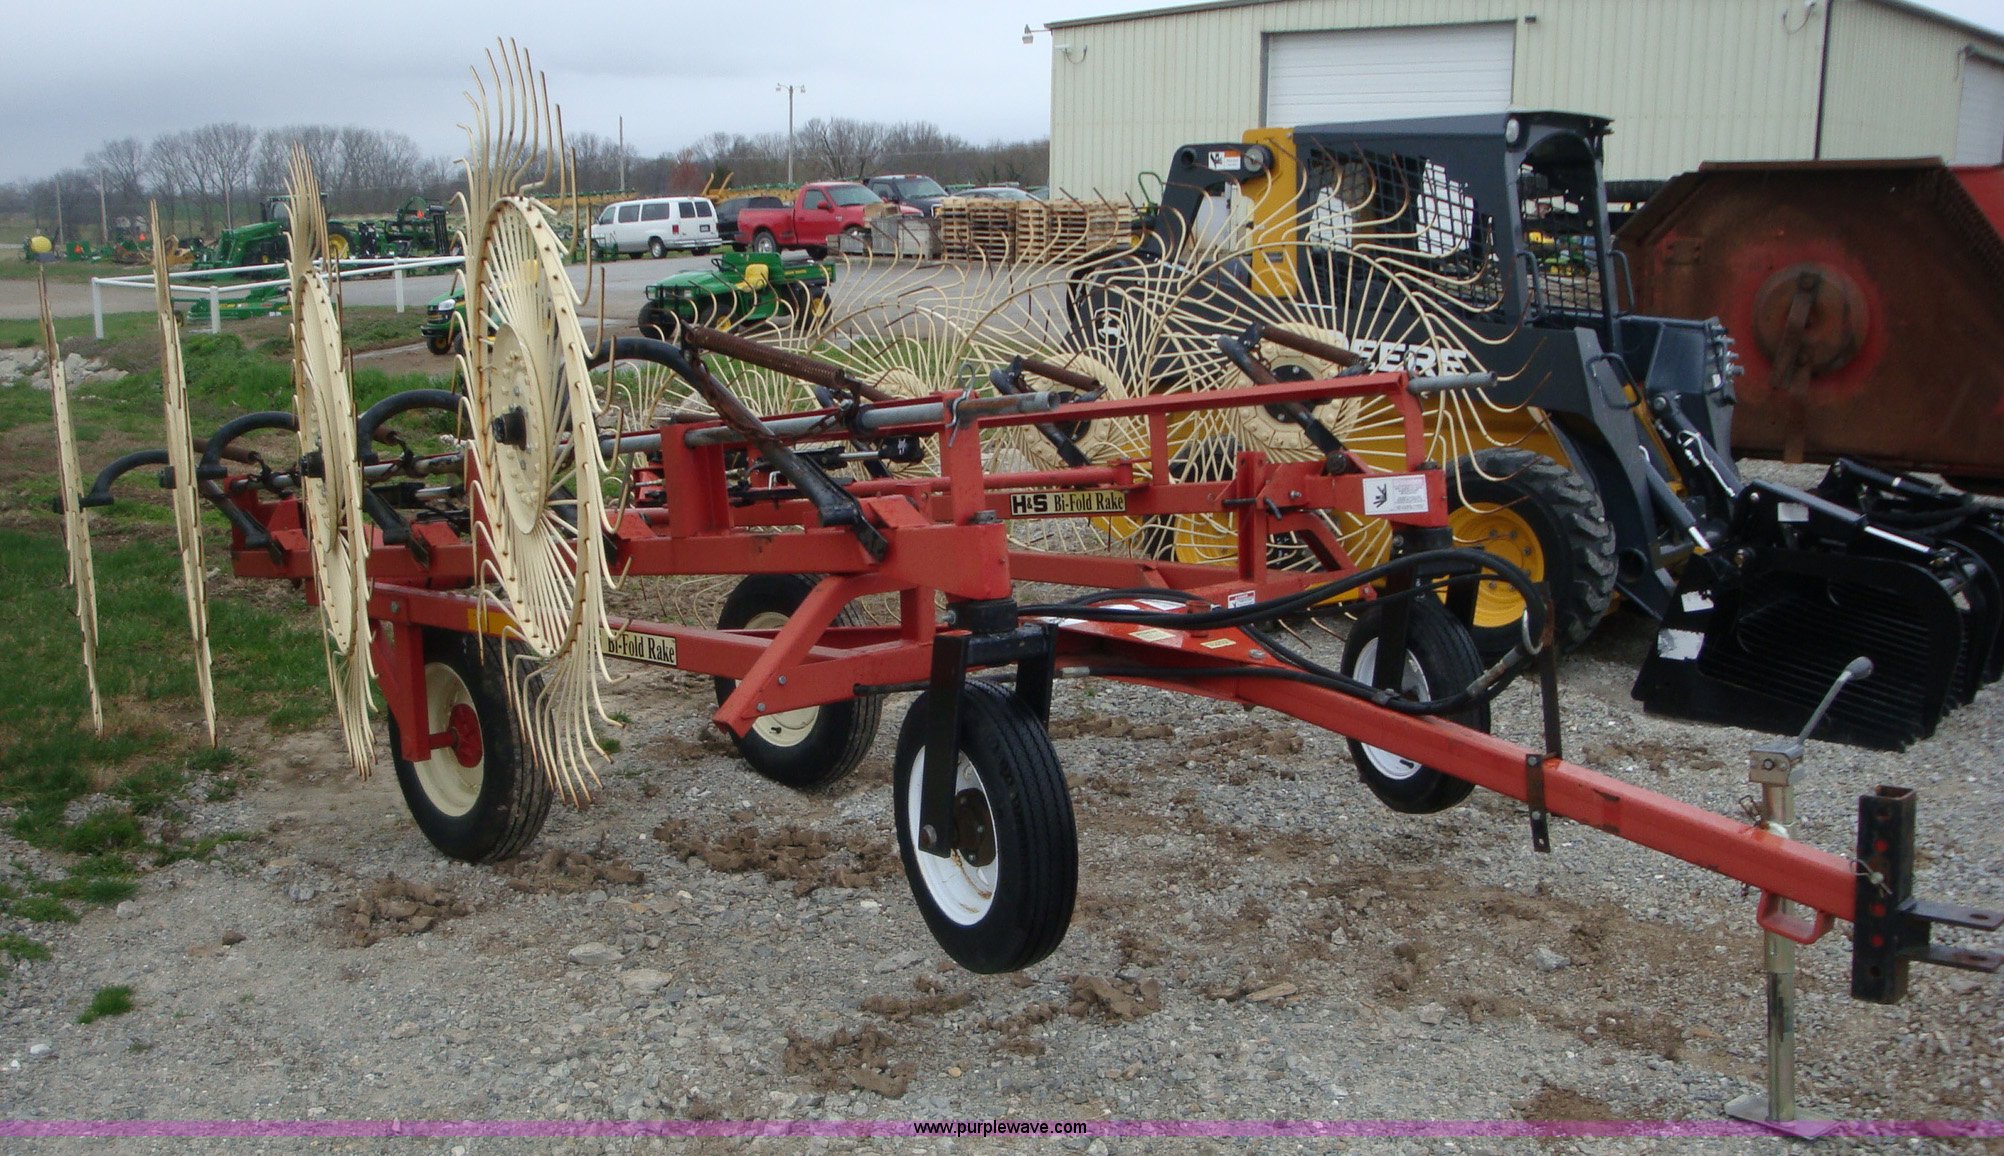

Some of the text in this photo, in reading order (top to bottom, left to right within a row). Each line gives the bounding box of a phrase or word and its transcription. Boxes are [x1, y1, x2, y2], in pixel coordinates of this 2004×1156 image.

[1012, 491, 1124, 513] H&S Bi-Fold Rake
[648, 637, 675, 663] Rake
